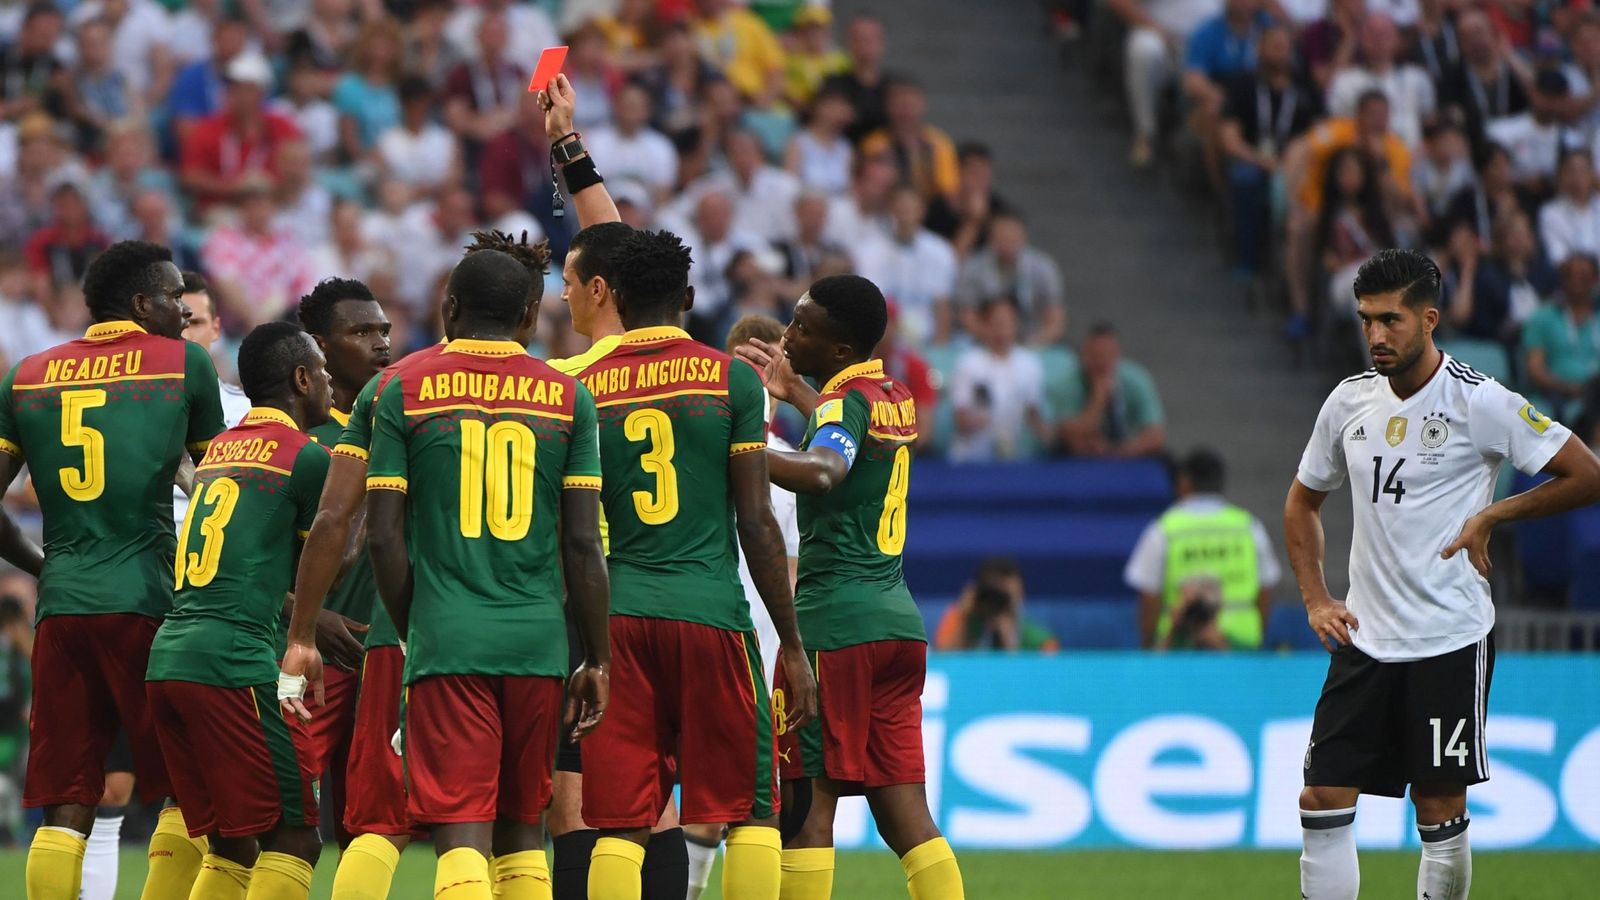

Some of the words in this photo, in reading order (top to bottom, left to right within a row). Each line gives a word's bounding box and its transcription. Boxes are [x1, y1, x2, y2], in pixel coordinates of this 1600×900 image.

[43, 349, 142, 384] NGADEU
[418, 371, 563, 406] ABOUBAKAR
[580, 365, 631, 397] AMBO
[635, 356, 721, 389] ANGUISSA
[58, 389, 107, 501] 5
[623, 408, 679, 525] 3
[459, 419, 536, 541] 10
[876, 445, 910, 556] 8
[1371, 456, 1406, 504] 14
[174, 476, 240, 592] 13
[771, 688, 787, 736] 8
[1429, 717, 1469, 767] 14
